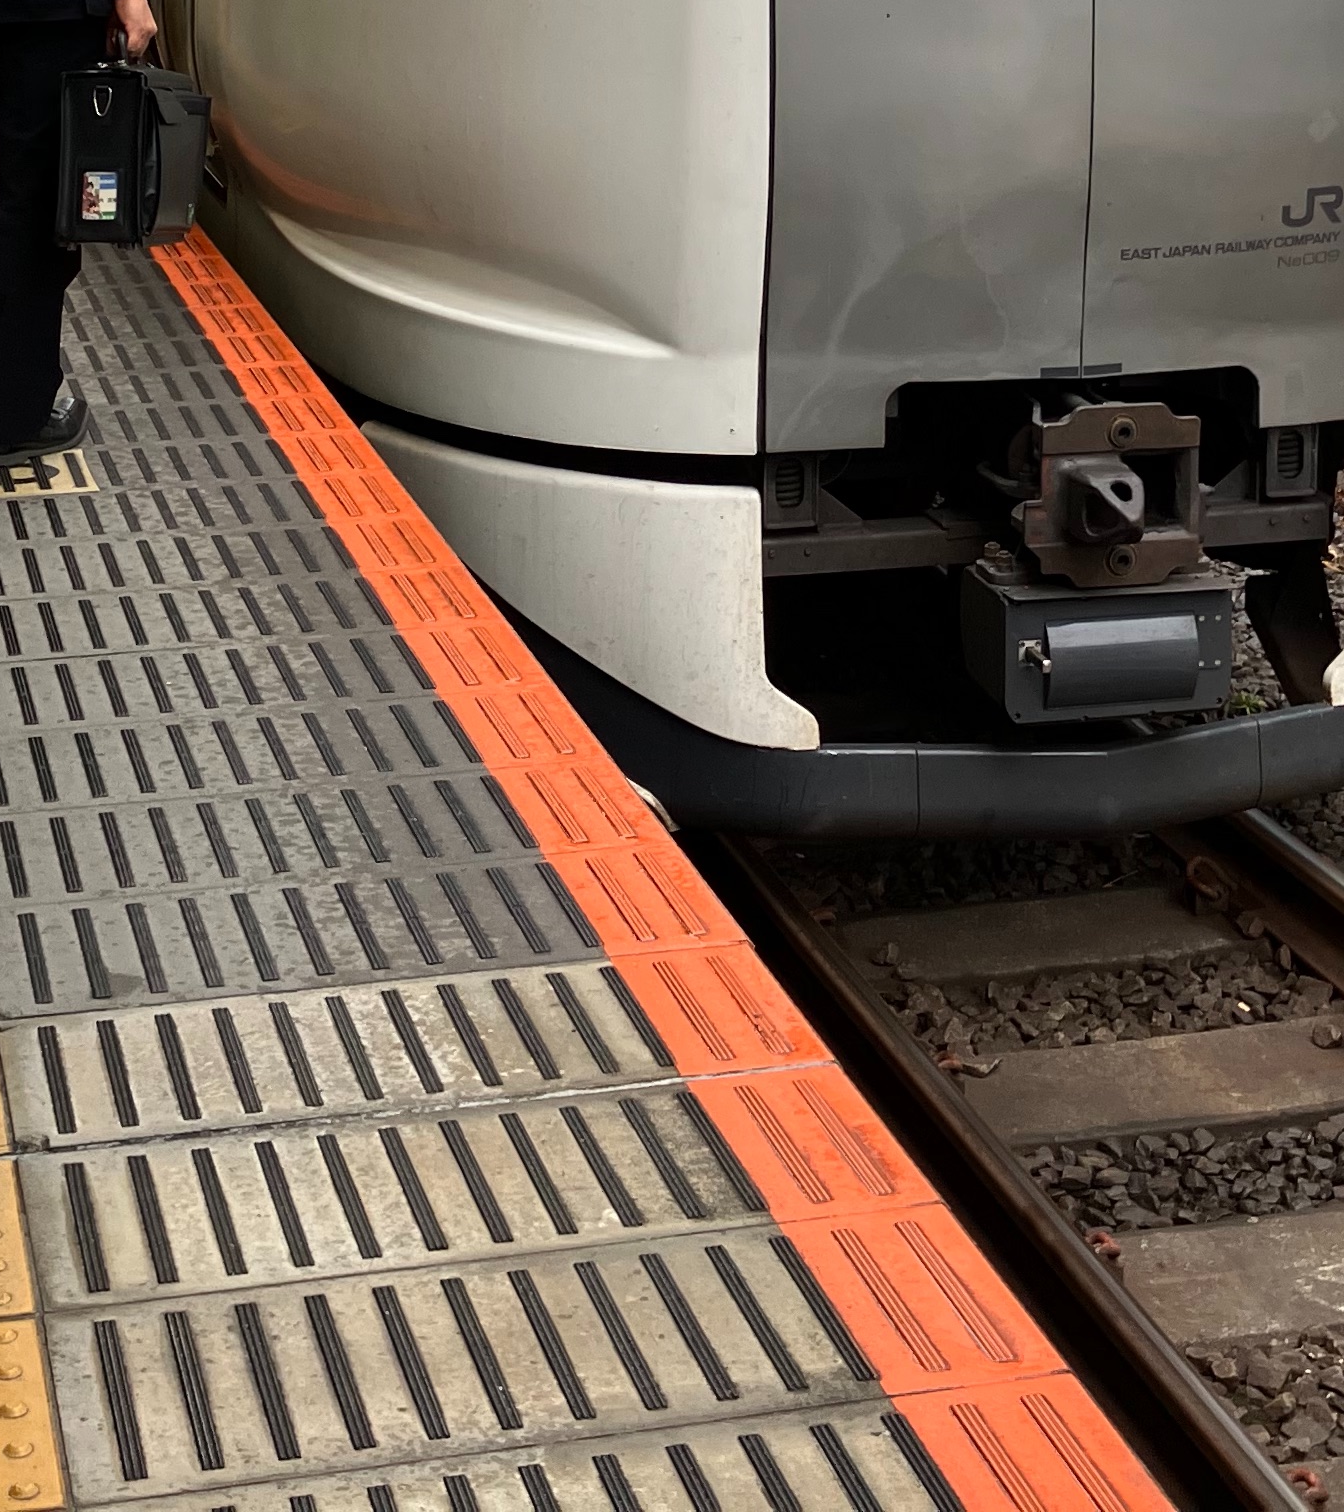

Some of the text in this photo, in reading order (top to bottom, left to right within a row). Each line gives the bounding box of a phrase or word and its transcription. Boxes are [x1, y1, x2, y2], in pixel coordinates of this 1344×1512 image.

[1281, 186, 1343, 228] JR
[1120, 231, 1341, 261] EAST JAPAN RAILWAY COMPANY
